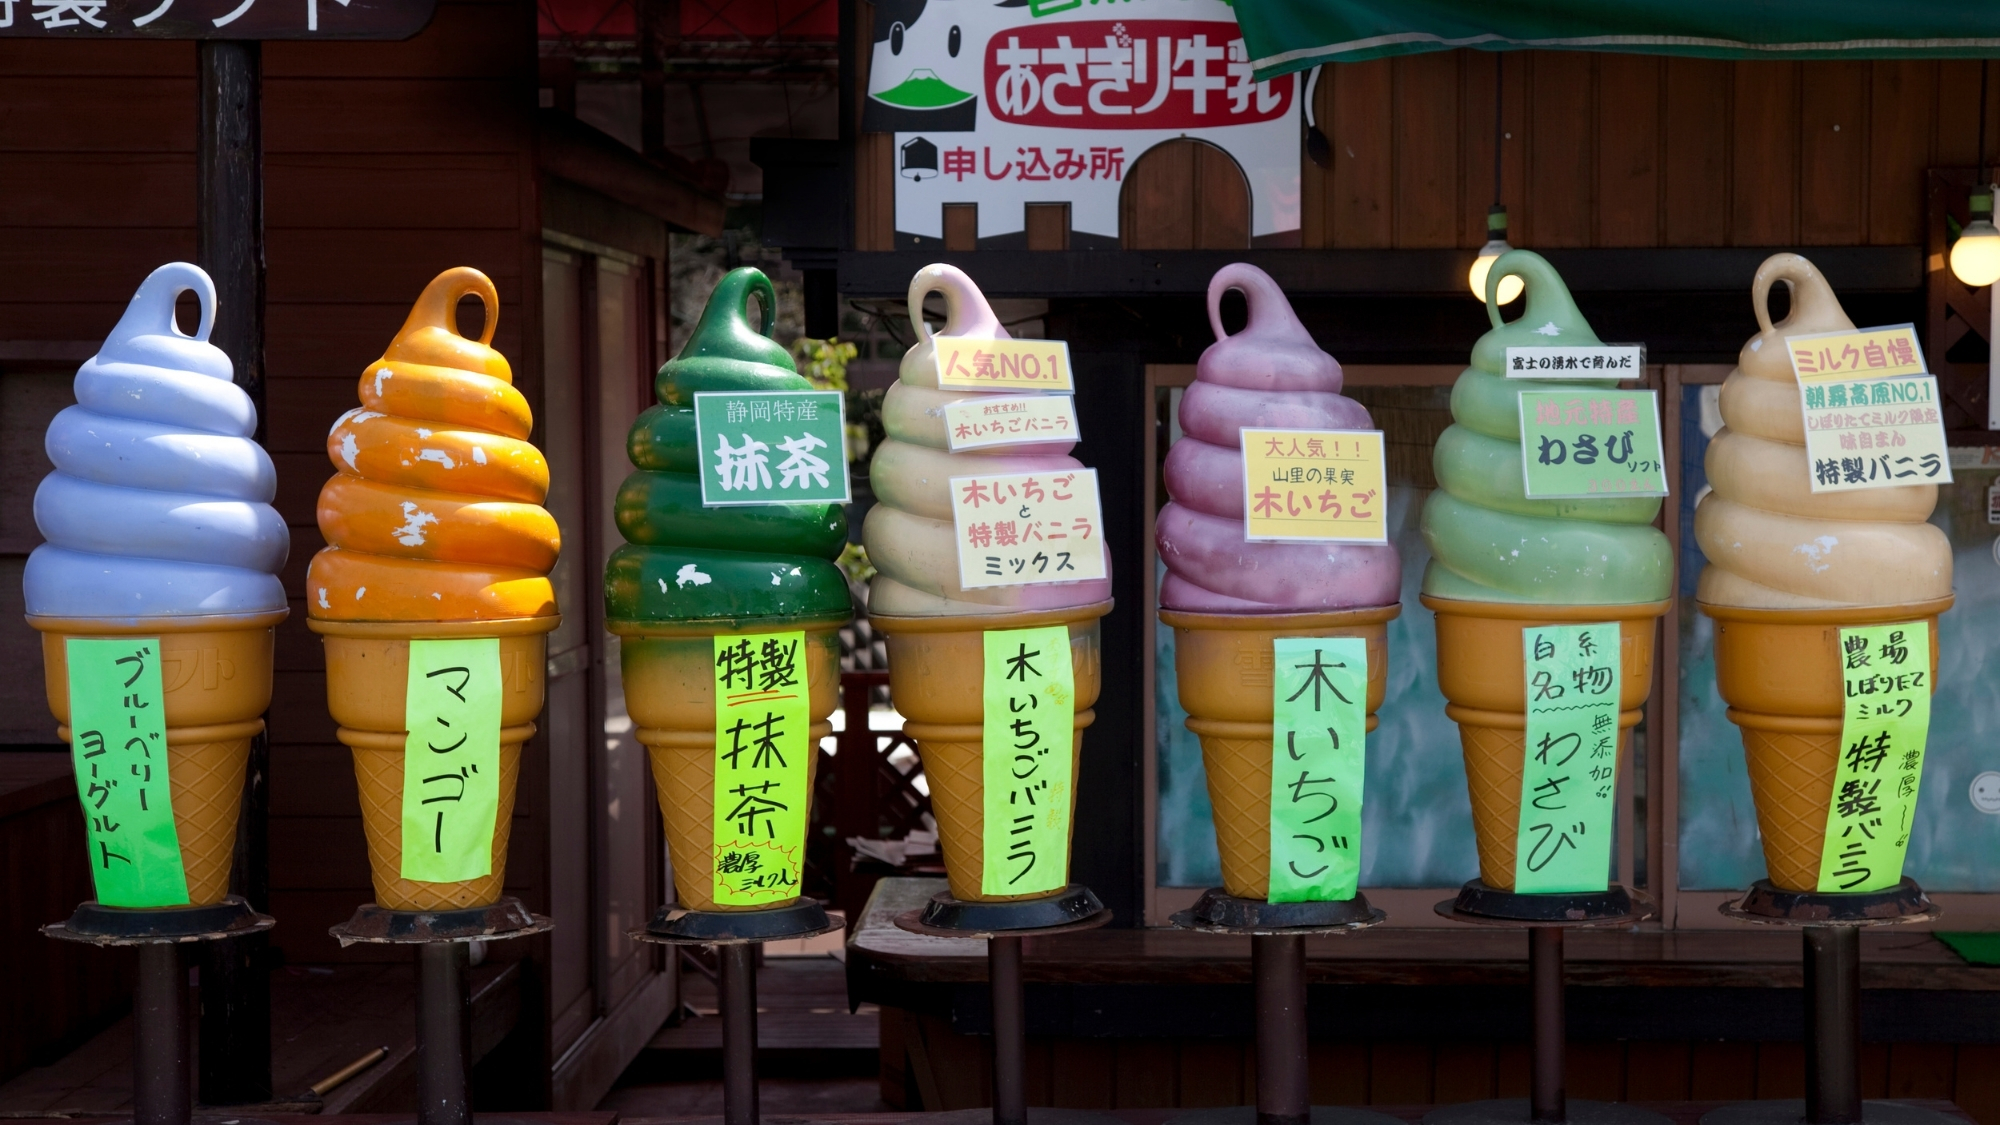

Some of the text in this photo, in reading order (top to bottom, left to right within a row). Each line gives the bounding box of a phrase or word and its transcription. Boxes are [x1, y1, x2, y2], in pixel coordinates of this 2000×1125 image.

[943, 146, 1125, 182] 申し込み所
[945, 349, 1058, 380] 人気NO.1
[1795, 338, 1917, 373] ミルク自慢
[725, 400, 818, 423] 静岡特産
[983, 403, 1026, 415] おすすめ!!
[1536, 398, 1640, 426] 地元特産
[1807, 408, 1939, 430] しぼりたてミルク限定
[955, 416, 1069, 439] 木いちごバニラ
[1839, 430, 1906, 450] 味自まん
[714, 432, 830, 491] 抹茶
[1538, 430, 1634, 465] わさび
[1273, 467, 1355, 486] 山里の果実
[1627, 460, 1661, 473] ソフト
[1815, 453, 1942, 485] 特製バニラ
[962, 473, 1075, 508] 木いちご
[1253, 486, 1376, 519] 木いちご
[1019, 505, 1031, 518] と
[968, 518, 1092, 548] 特製バニラ
[985, 551, 1075, 576] ミックス
[1534, 631, 1597, 661] 白糸
[1844, 631, 1907, 669] 農場
[716, 639, 798, 692] 特製
[1531, 666, 1613, 701] 名物
[1846, 672, 1924, 697] しぼりたて
[1856, 699, 1912, 719] ミルク
[115, 647, 160, 811] ブルーベリー
[421, 665, 479, 853] マンゴー
[721, 712, 788, 839] 抹茶
[1006, 643, 1049, 885] 木いちごバニラ
[1285, 649, 1353, 878] 木いちご
[79, 730, 131, 869] ヨーグルト
[1527, 732, 1585, 872] わさび
[1832, 730, 1891, 889] 特製バニラ
